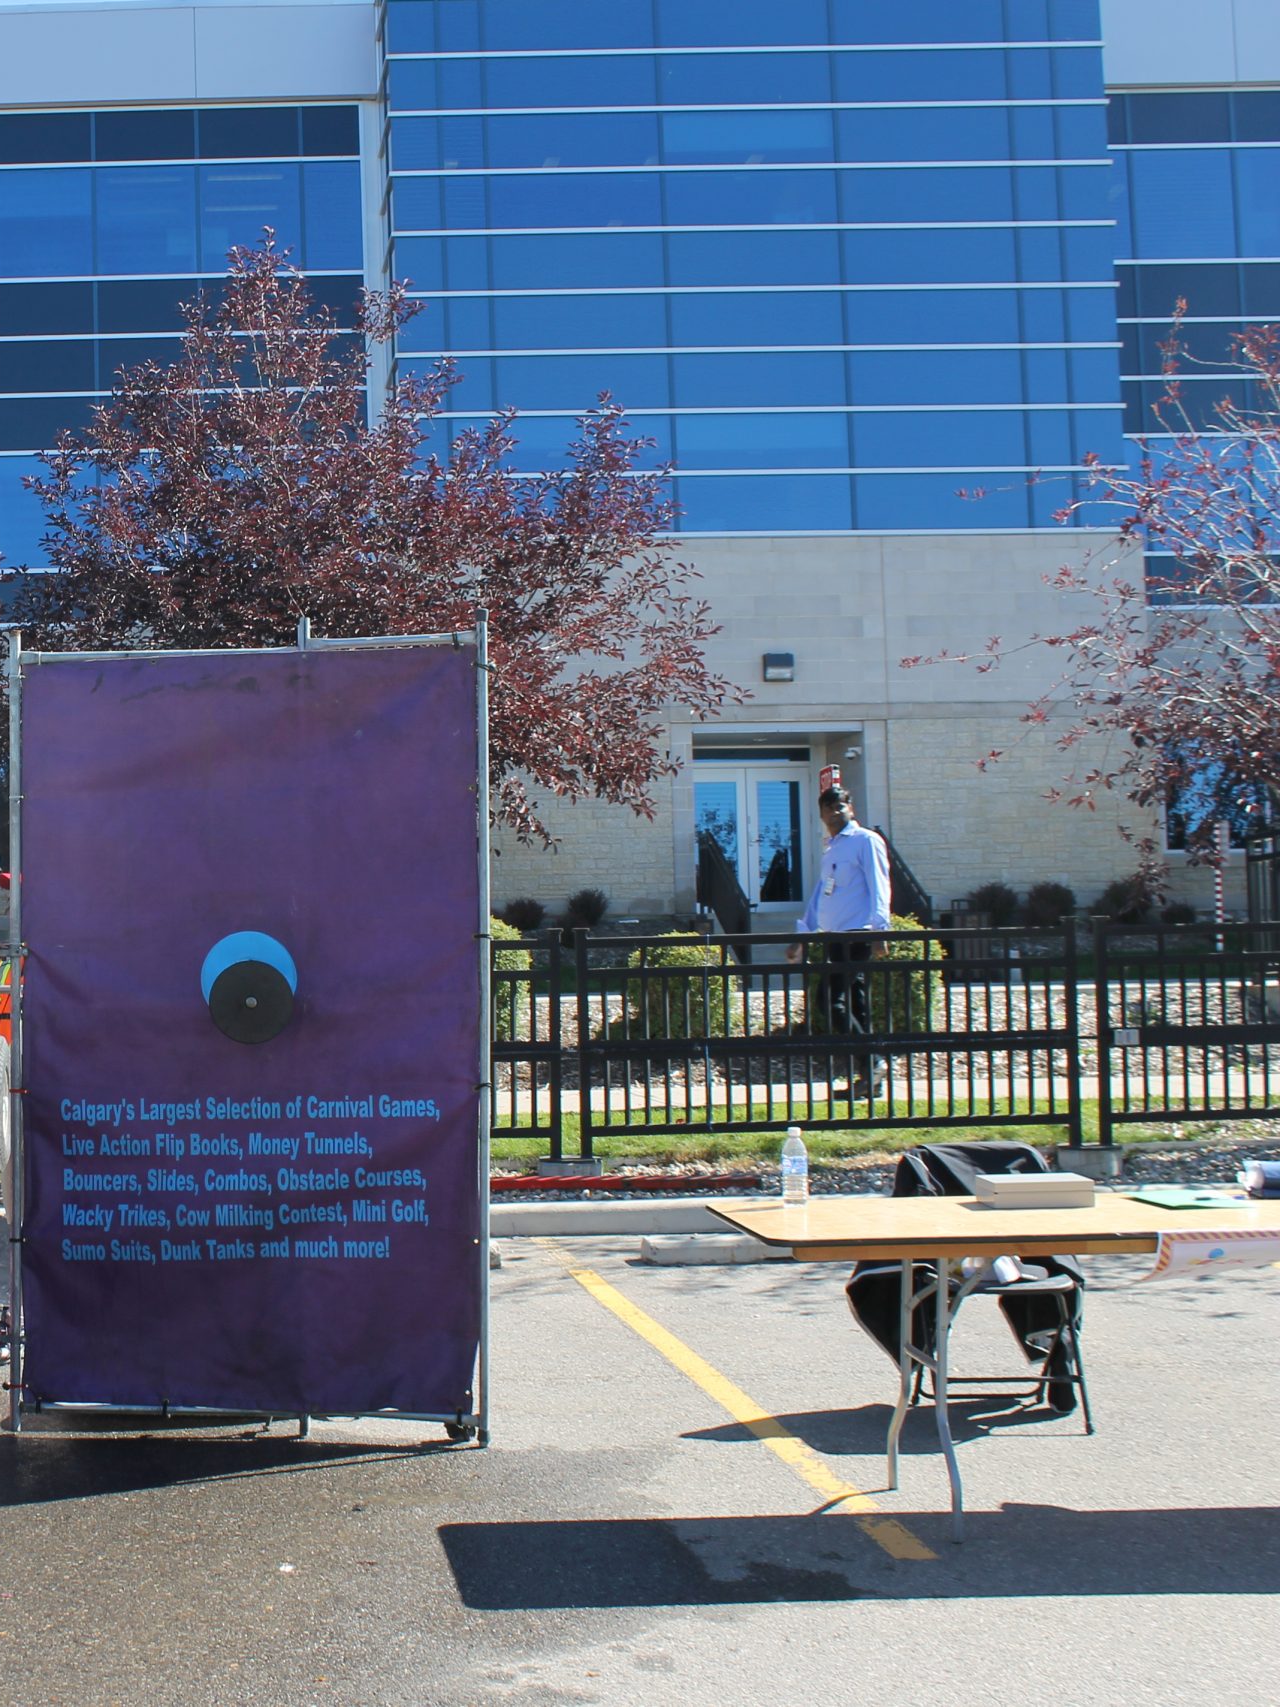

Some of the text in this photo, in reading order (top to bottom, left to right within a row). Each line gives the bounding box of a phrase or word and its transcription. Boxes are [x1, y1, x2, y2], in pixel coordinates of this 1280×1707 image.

[60, 1094, 442, 1127] Calgary's Largest Selection of Carnival Games,
[63, 1131, 374, 1161] Live Action Flip Books, Money Tunnels,
[63, 1167, 428, 1196] Bouncers, Slides, Combos, Obstacle Courses,
[62, 1199, 430, 1232] Wacky Trikes, Cow Milking Contest, Mini Golf,
[62, 1236, 390, 1266] Sumo Suits, Dunk Tanks and much more!
